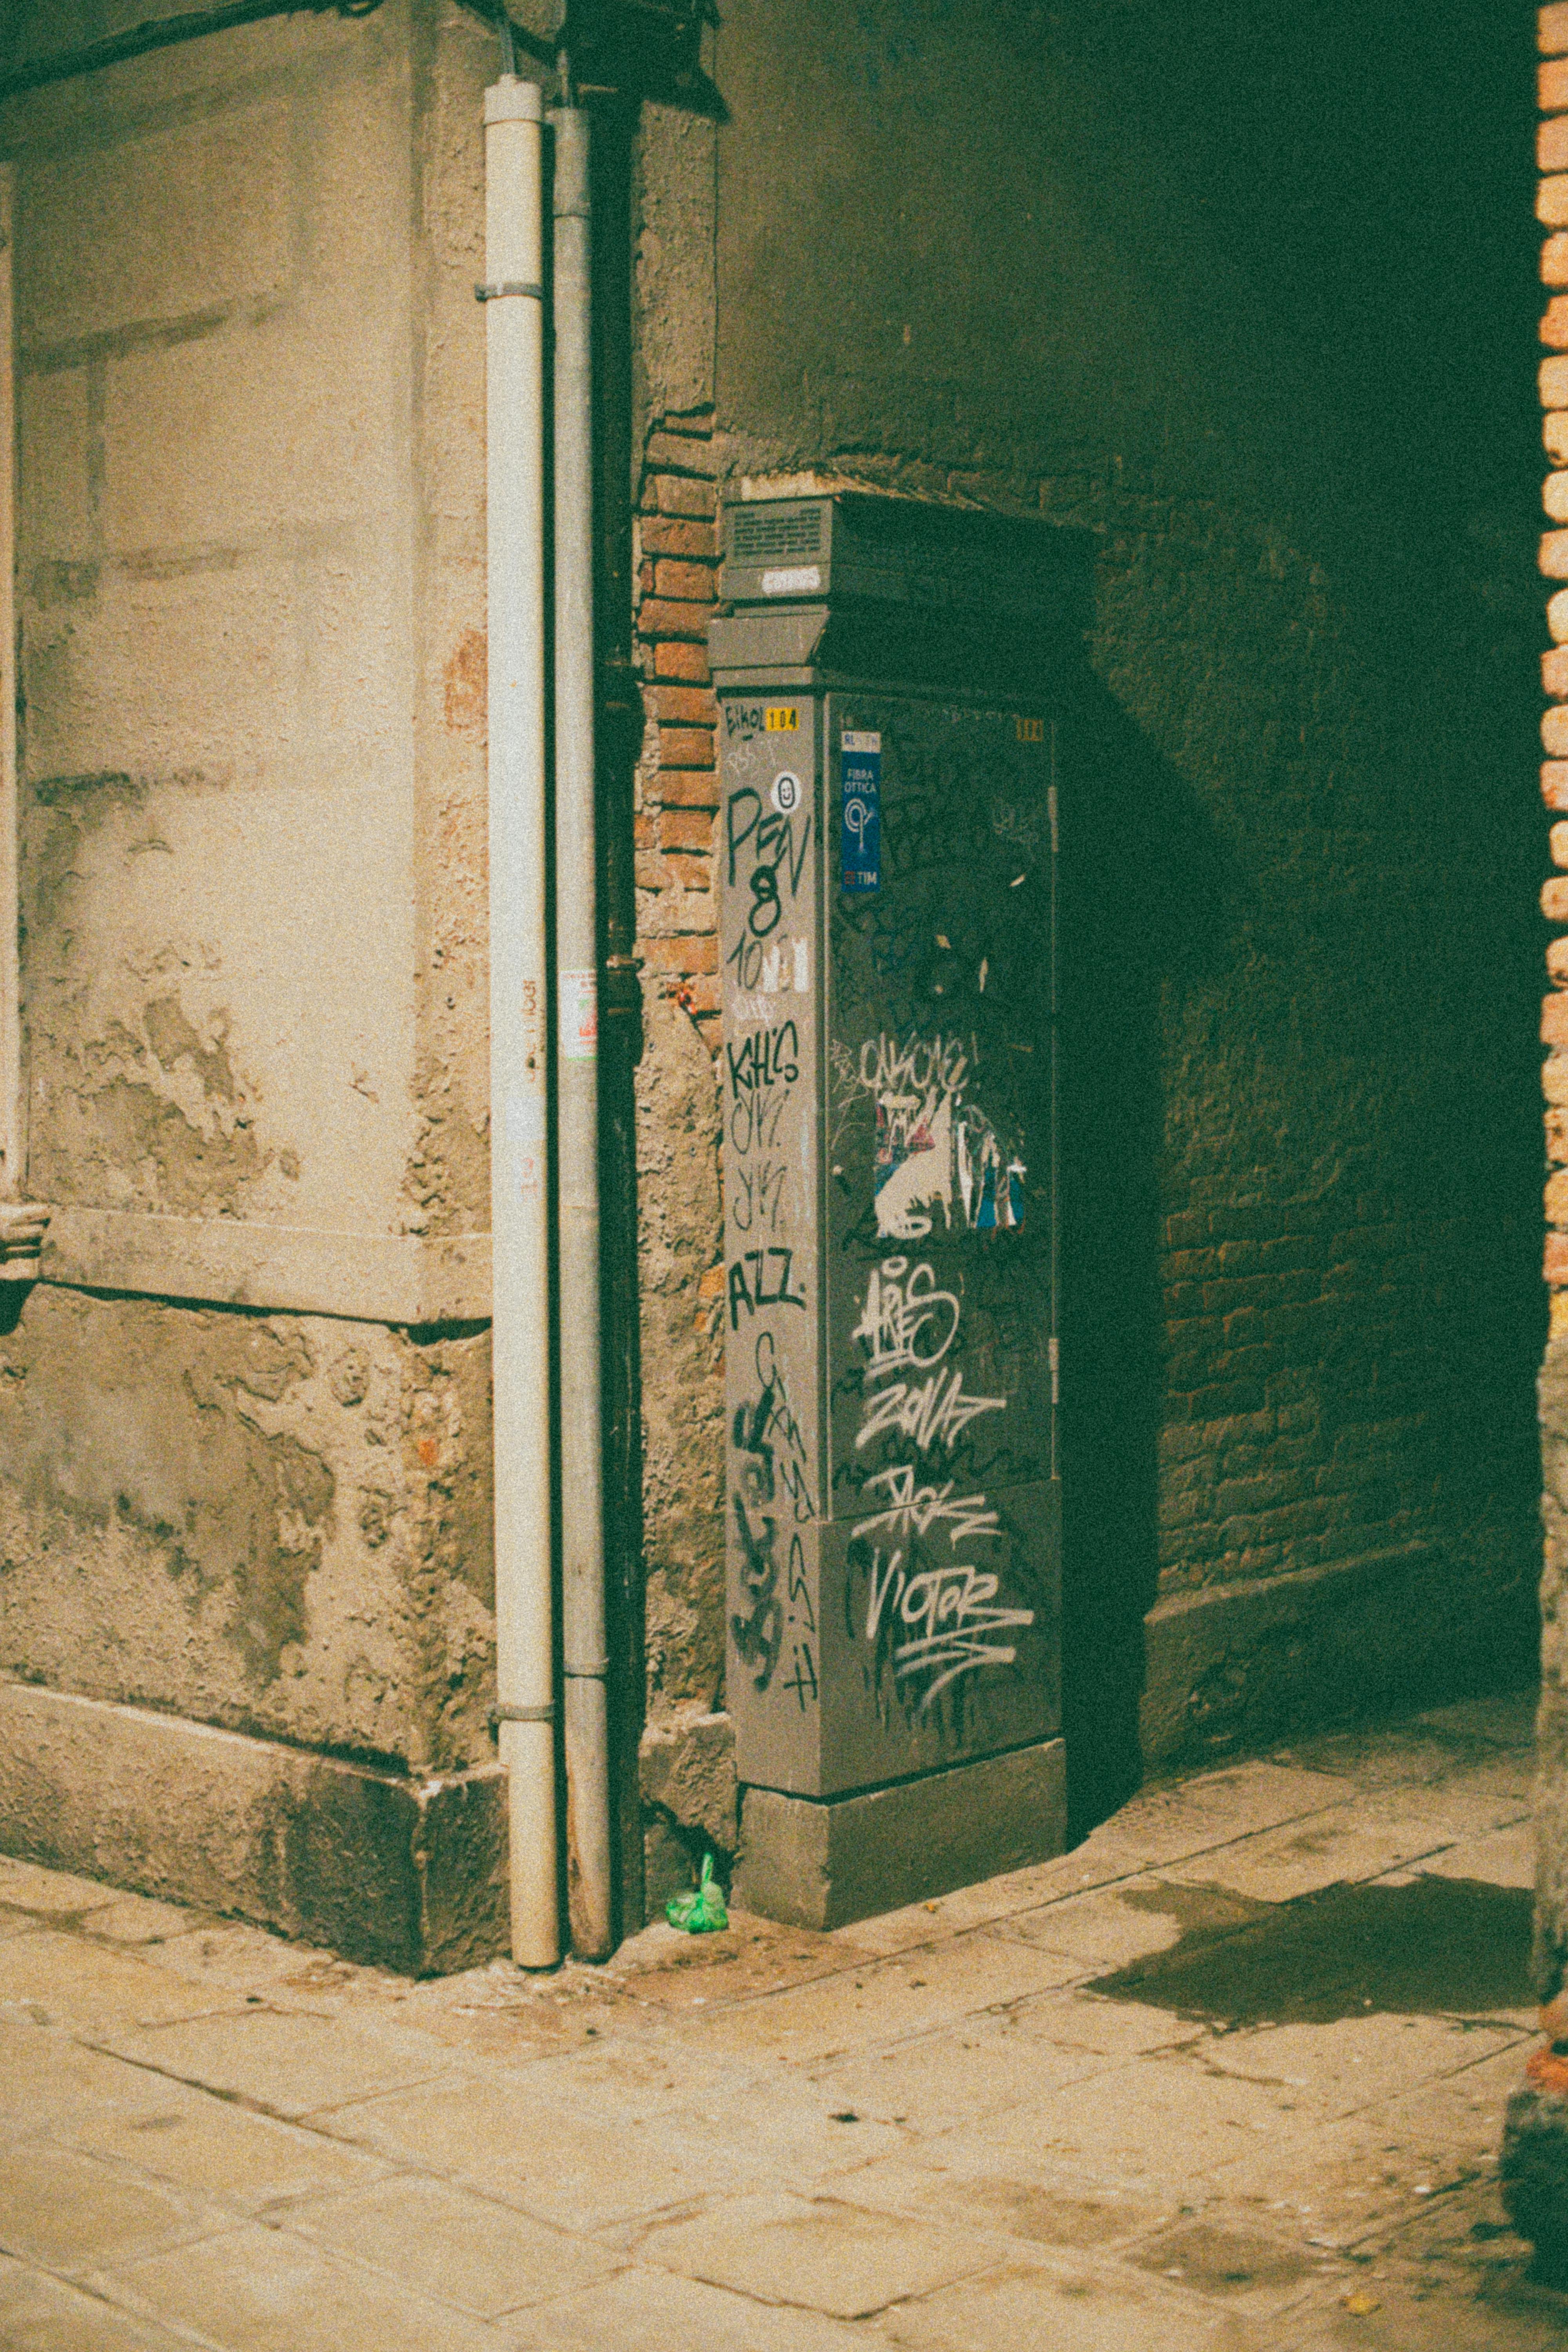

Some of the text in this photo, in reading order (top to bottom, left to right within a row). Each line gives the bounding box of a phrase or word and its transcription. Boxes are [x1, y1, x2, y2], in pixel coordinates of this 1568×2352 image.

[770, 709, 797, 729] 104
[847, 768, 873, 780] FIBRA
[844, 781, 877, 793] OTTICA
[858, 871, 877, 884] TIM
